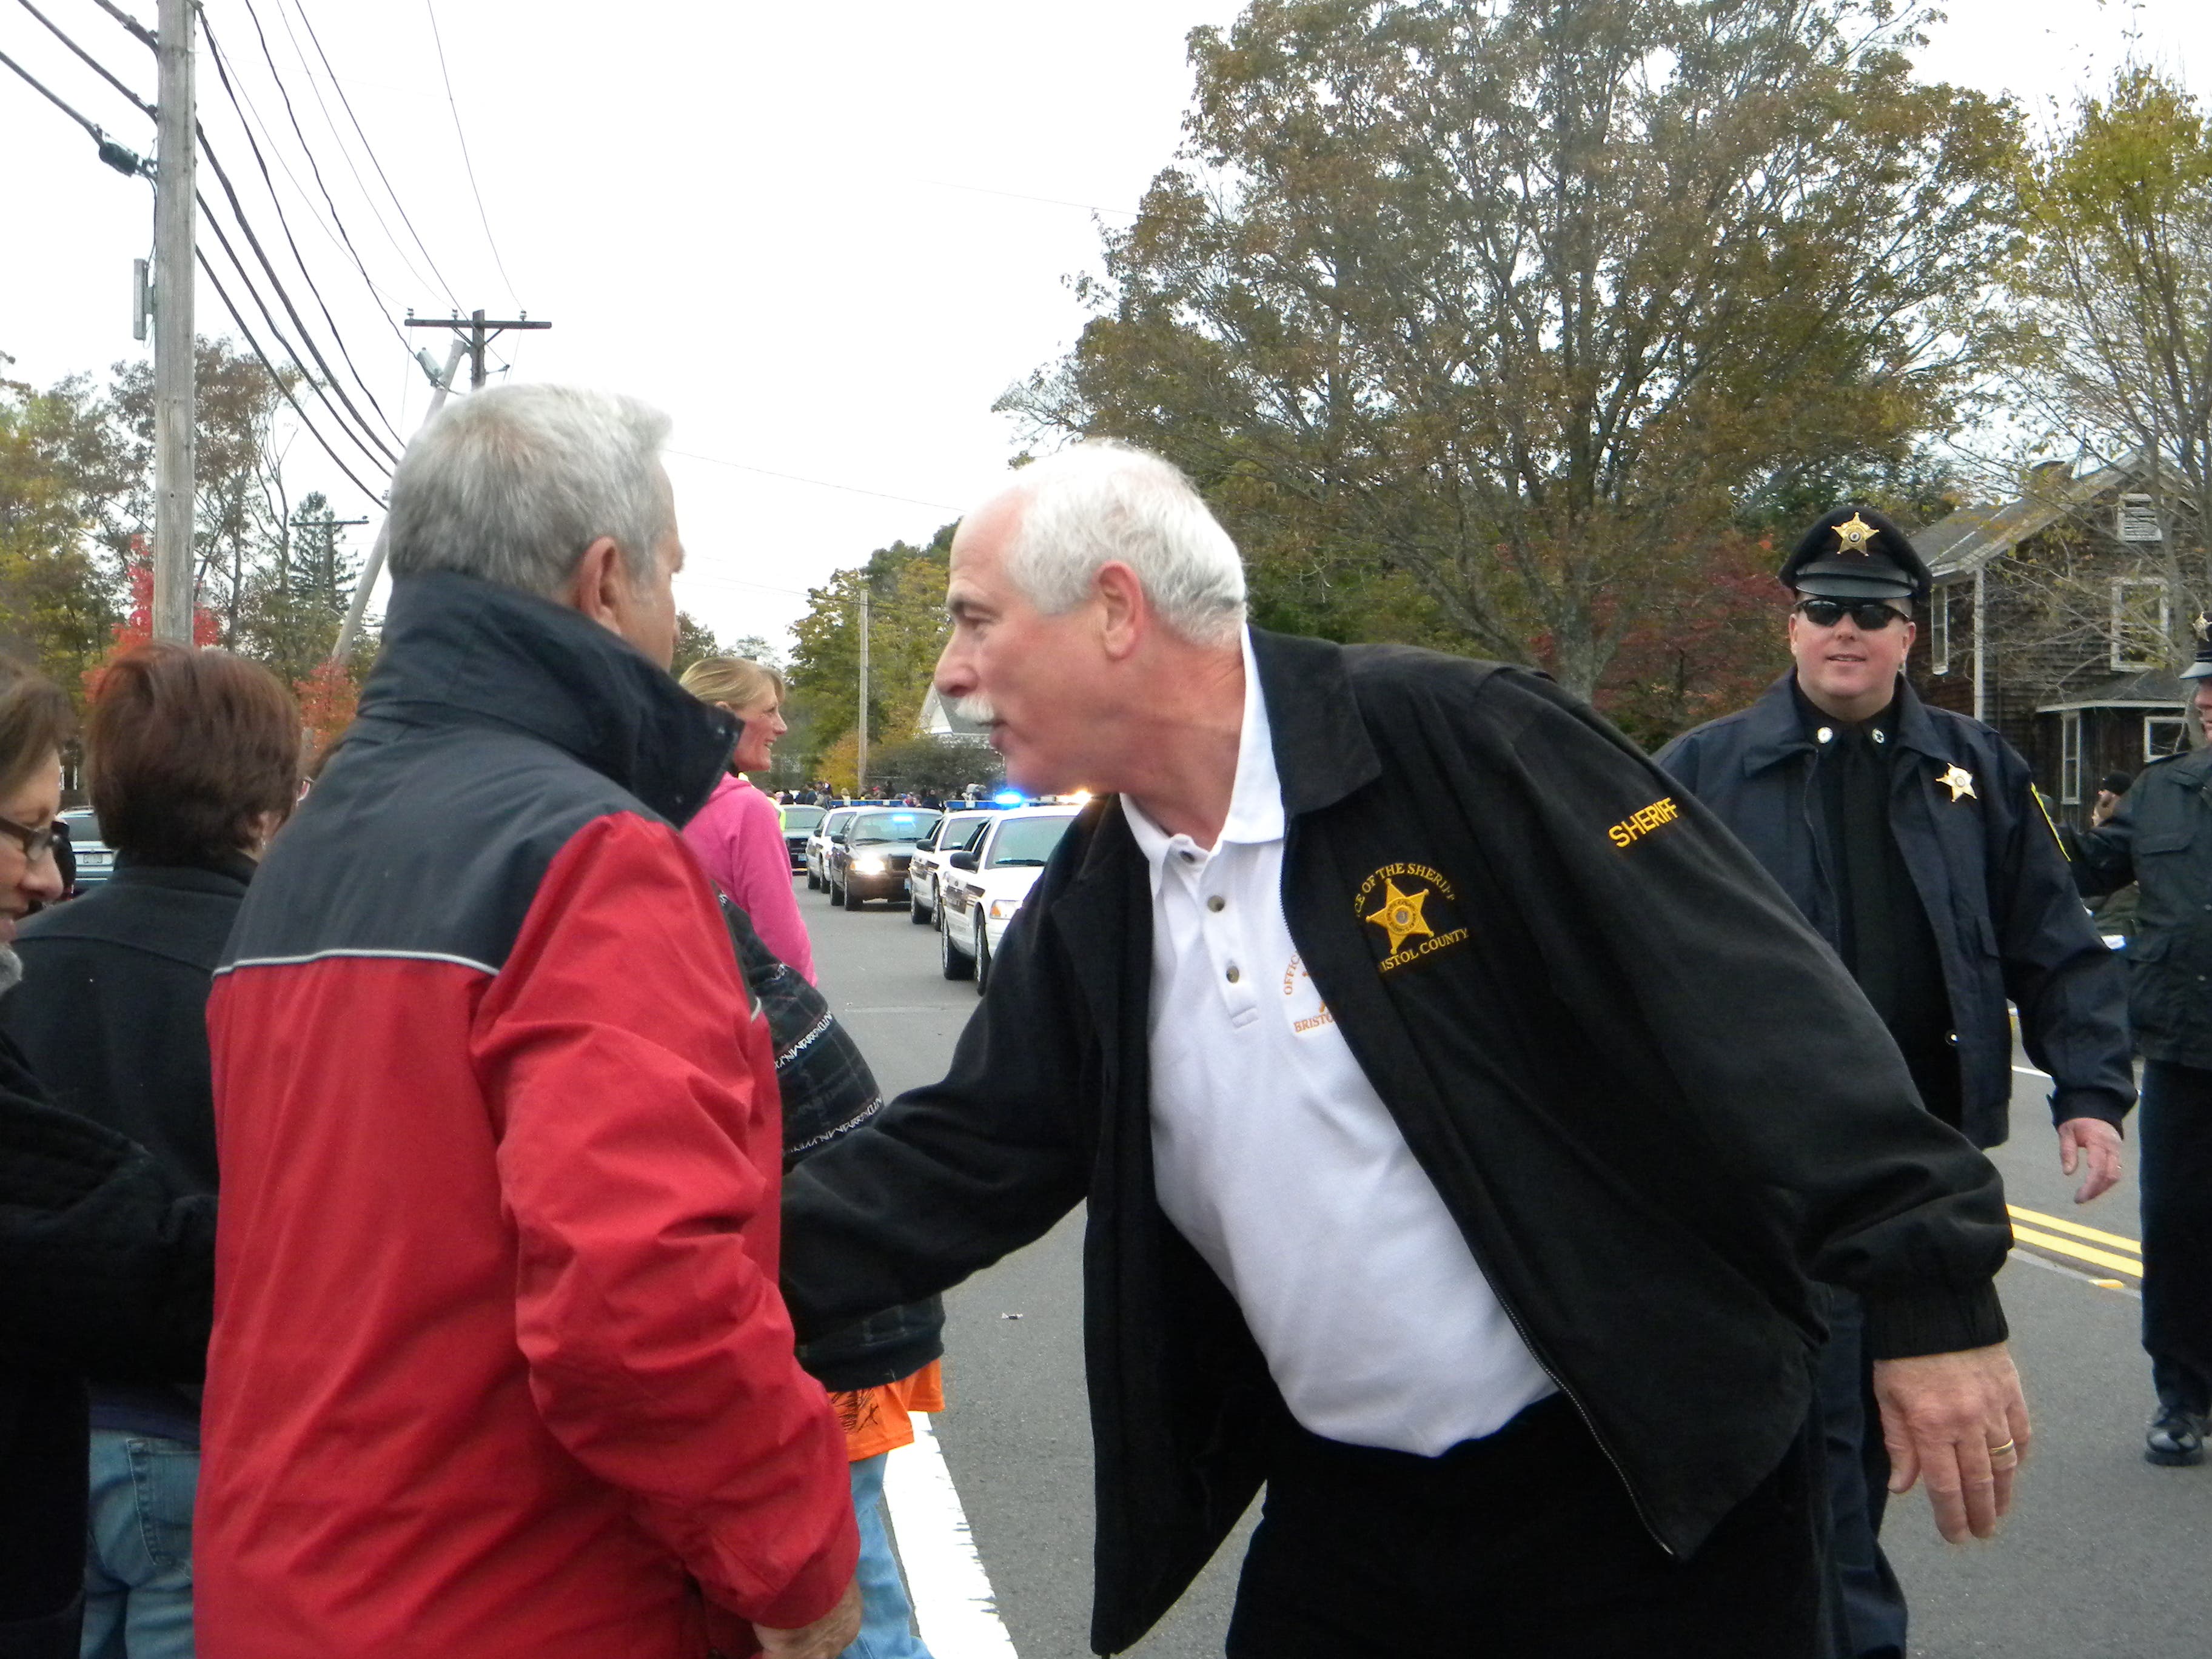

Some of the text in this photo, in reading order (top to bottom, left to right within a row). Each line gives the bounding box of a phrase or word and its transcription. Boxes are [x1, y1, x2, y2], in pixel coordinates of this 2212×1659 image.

[1609, 797, 1678, 848] SHERIFF
[1362, 875, 1376, 893] OF
[1375, 863, 1405, 879] THE
[1419, 928, 1469, 953] COUNTY
